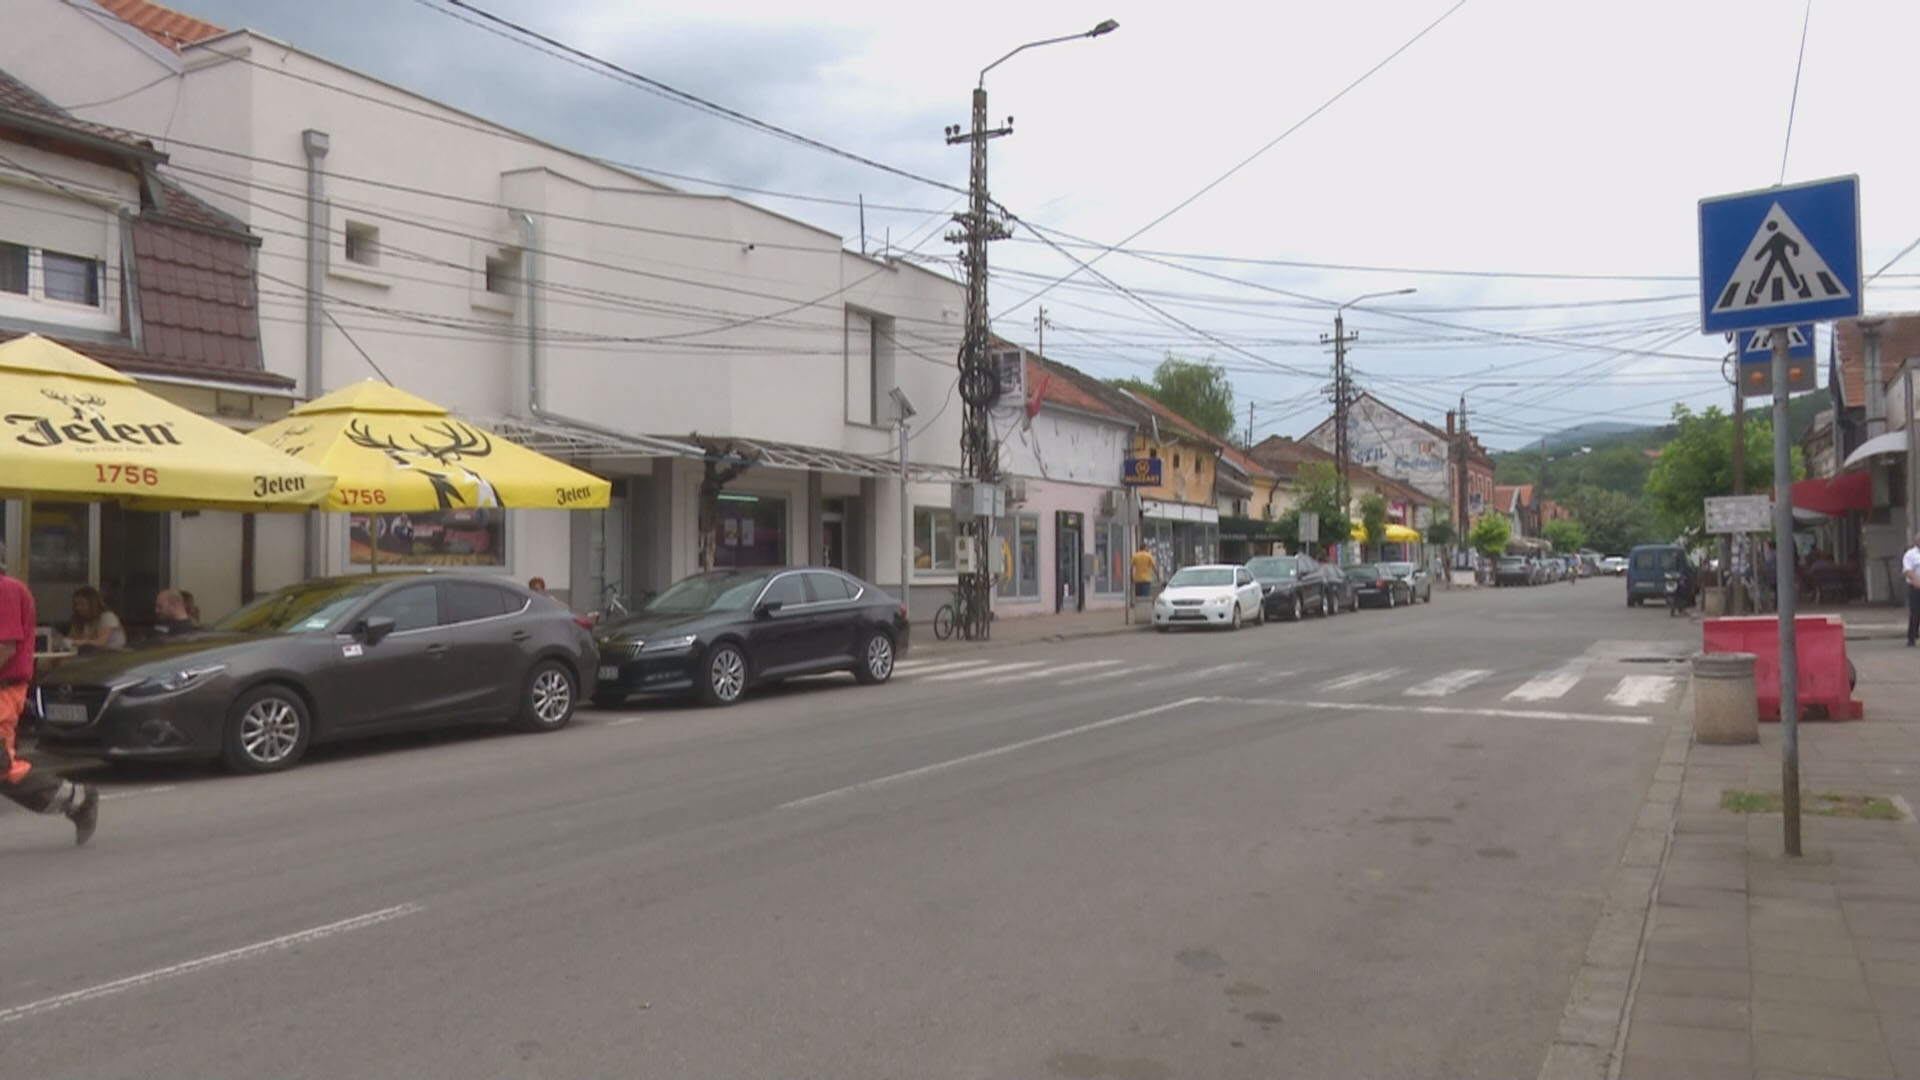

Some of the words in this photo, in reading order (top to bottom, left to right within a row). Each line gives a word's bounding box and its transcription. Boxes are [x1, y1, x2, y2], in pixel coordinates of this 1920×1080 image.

[4, 414, 181, 447] Jelen
[96, 464, 158, 486] 1756
[253, 475, 305, 498] Jelen
[339, 489, 387, 506] 1756
[555, 486, 591, 505] Jelen
